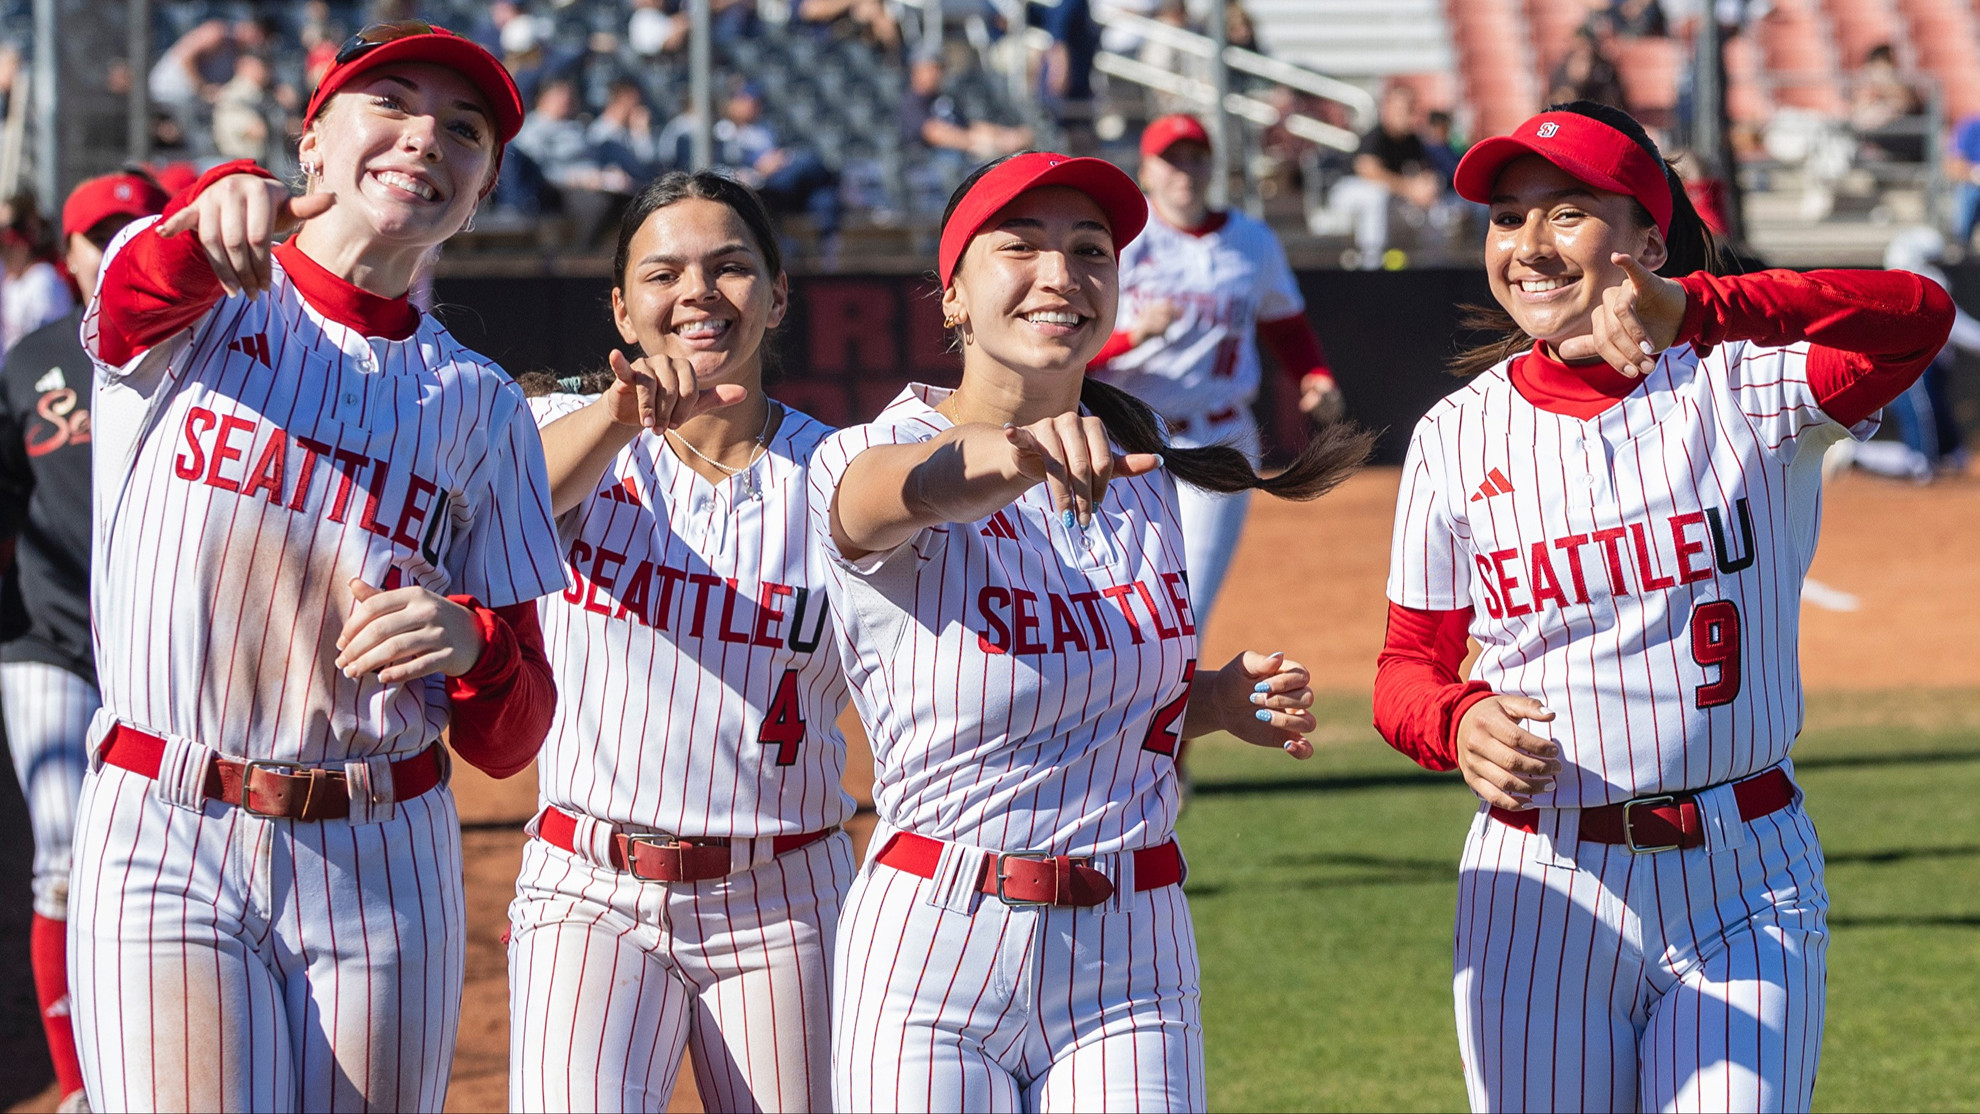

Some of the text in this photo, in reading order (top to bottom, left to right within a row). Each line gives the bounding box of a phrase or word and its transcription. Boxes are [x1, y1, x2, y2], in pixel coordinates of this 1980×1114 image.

[175, 406, 449, 567] SEATTLEU
[563, 538, 829, 653] SEATTLEU
[977, 569, 1196, 655] SEATTLE
[1475, 497, 1755, 620] SEATTLEU
[1690, 599, 1741, 710] 9
[757, 668, 806, 766] 4
